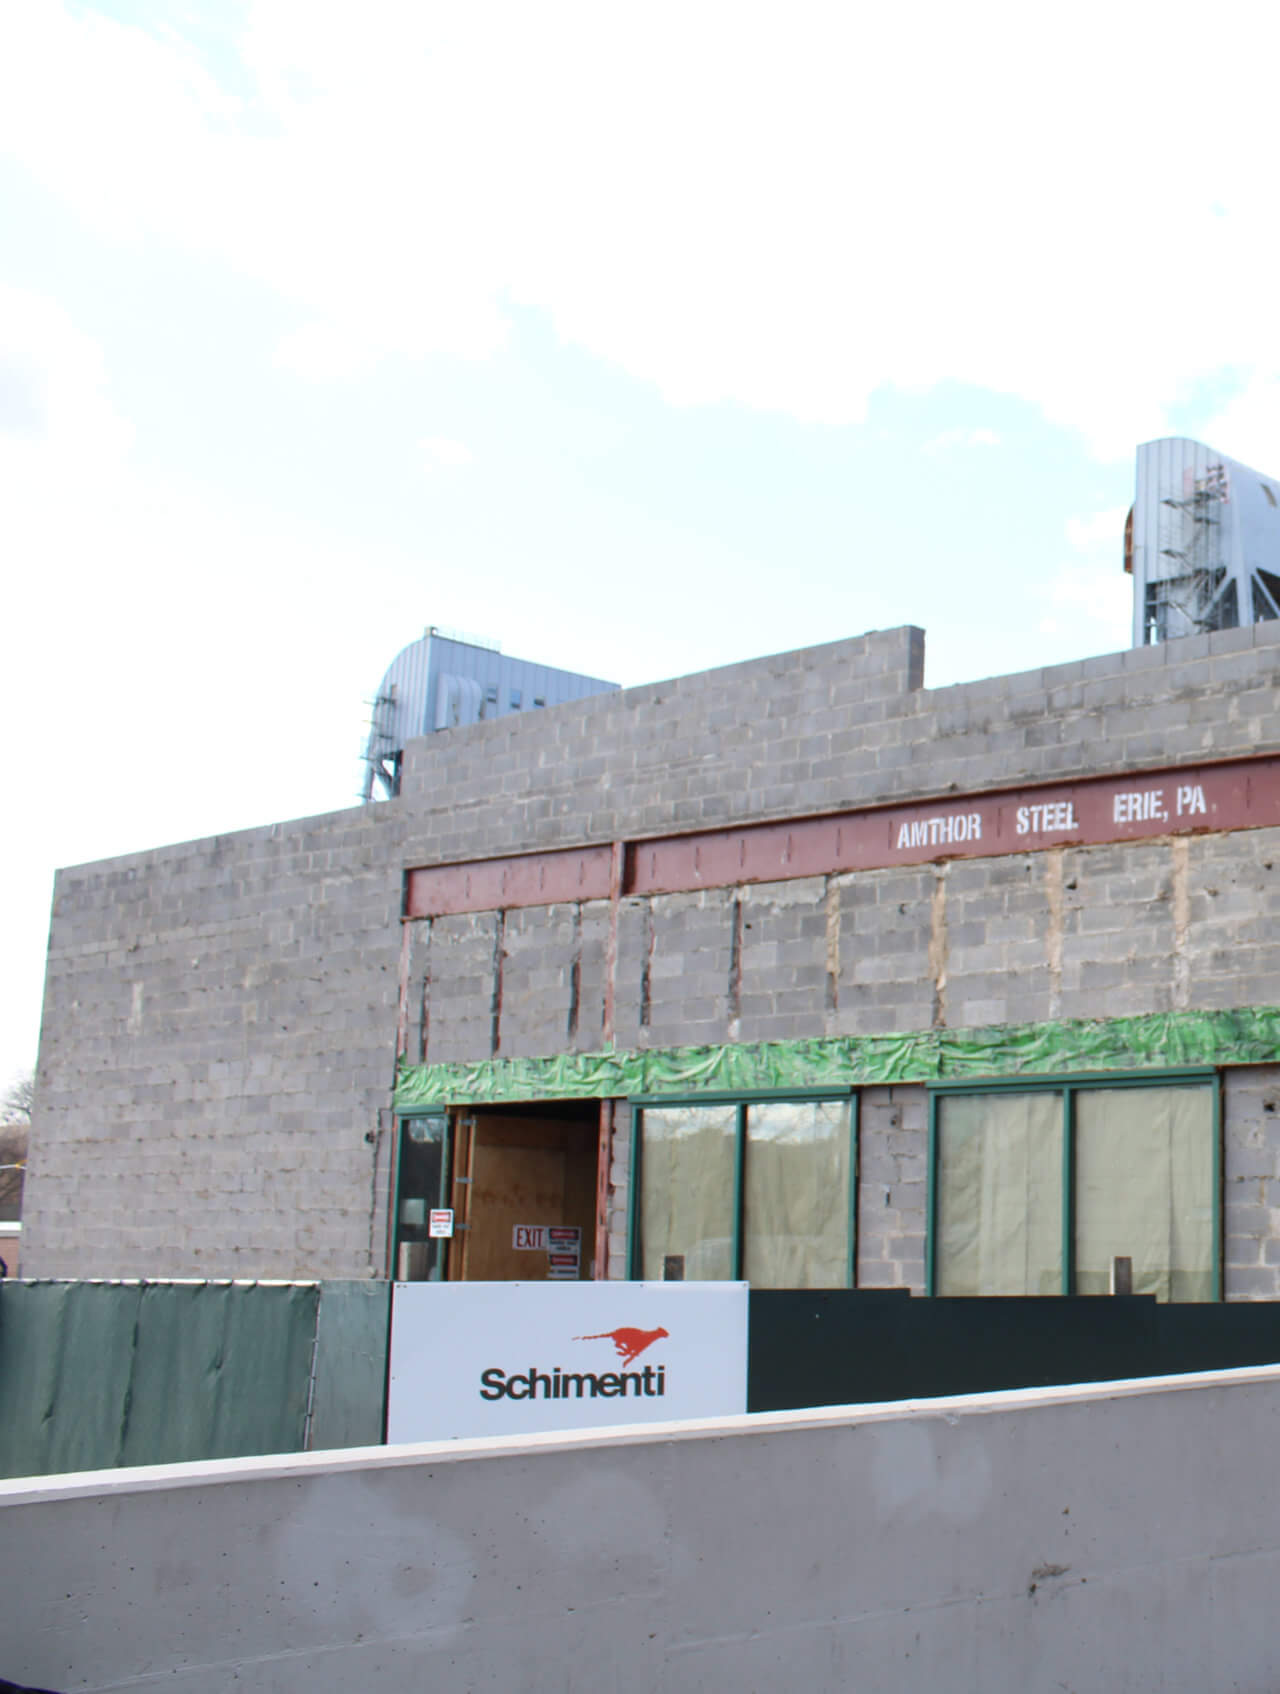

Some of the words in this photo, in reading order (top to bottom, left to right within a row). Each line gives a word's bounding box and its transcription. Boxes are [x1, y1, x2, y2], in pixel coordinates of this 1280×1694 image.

[897, 814, 982, 849] AMTHOR
[1016, 802, 1079, 834] STEEL
[1114, 790, 1169, 823] ERIE,
[1178, 786, 1207, 817] PA
[516, 1227, 544, 1249] EXIT
[480, 1365, 665, 1401] Schimenti
